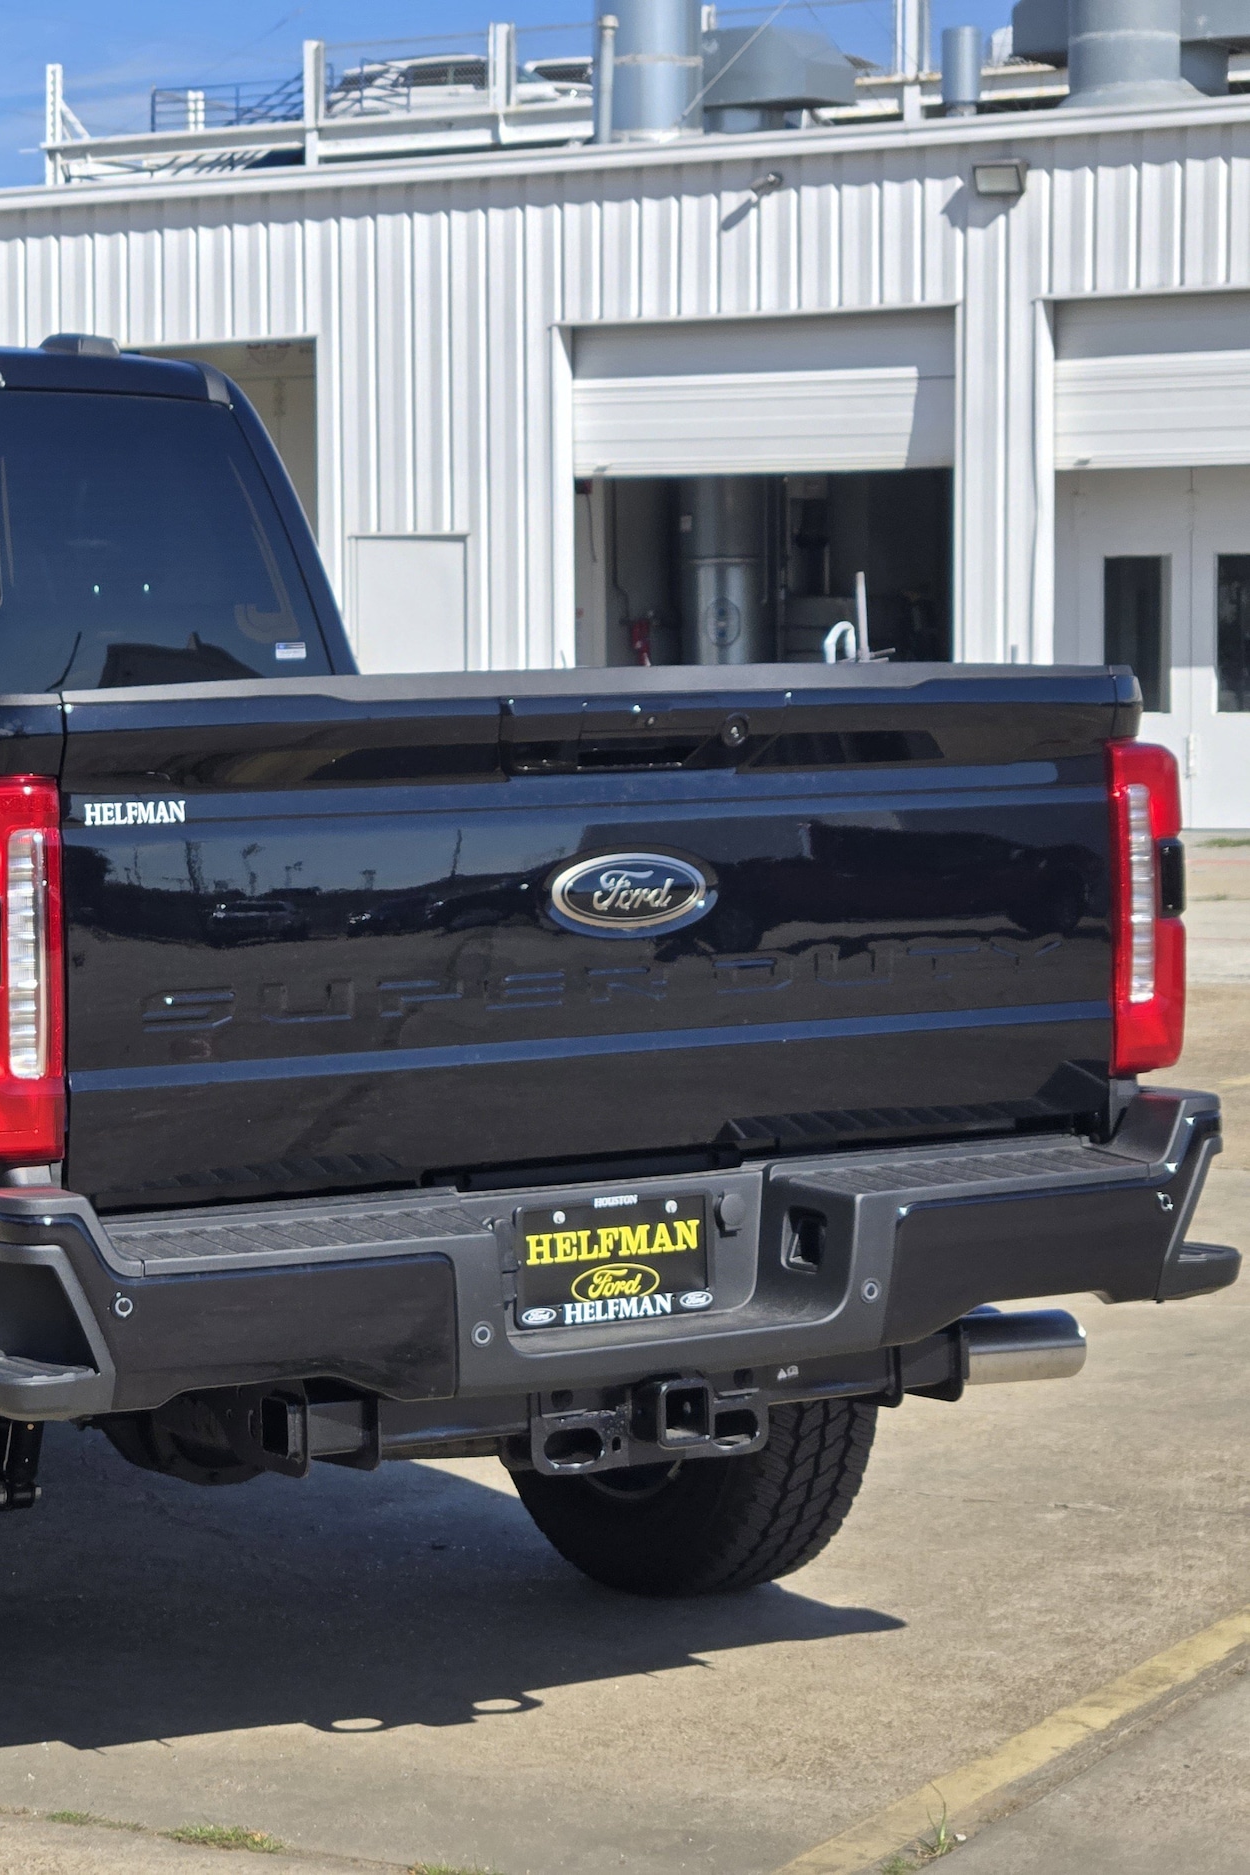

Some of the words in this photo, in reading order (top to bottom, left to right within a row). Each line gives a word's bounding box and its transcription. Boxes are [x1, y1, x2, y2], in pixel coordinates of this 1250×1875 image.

[84, 800, 186, 826] HELFMAN
[593, 869, 675, 911] Ford
[140, 965, 668, 1033] SUPER
[594, 1194, 638, 1209] HOUSTON
[526, 1219, 700, 1266] HELFMAN
[587, 1268, 642, 1299] Ford
[564, 1292, 673, 1325] HELFMAN
